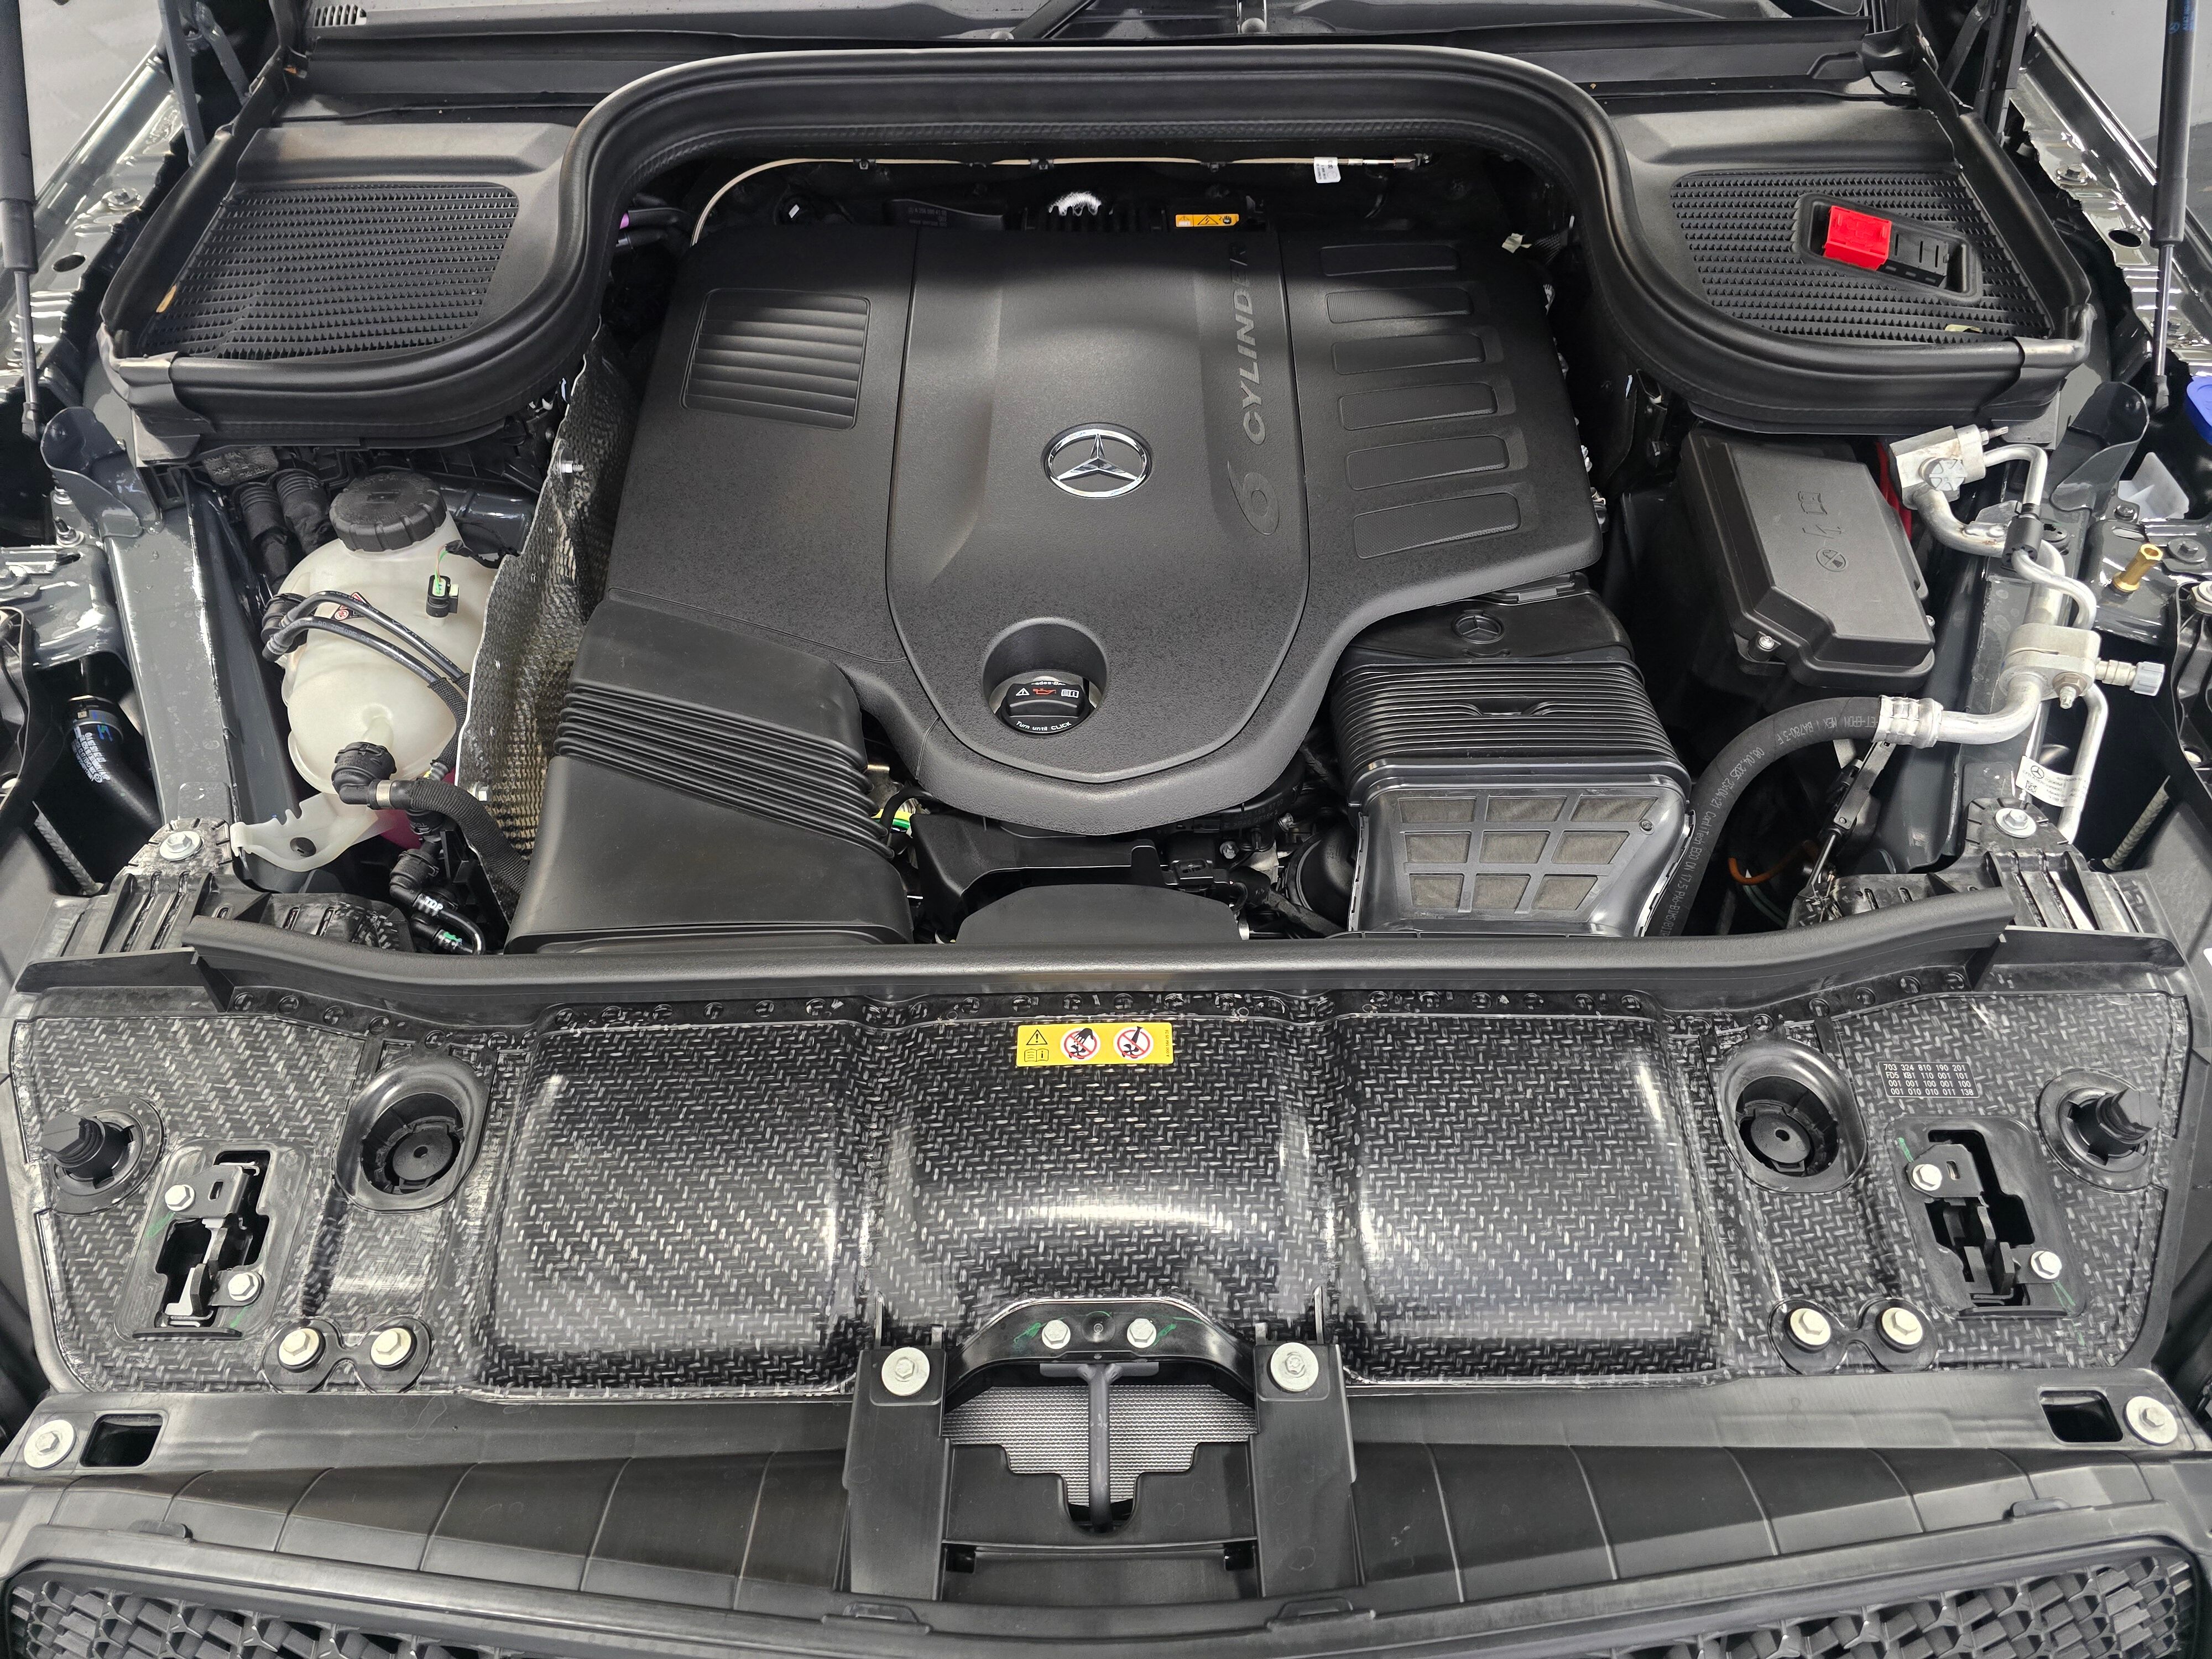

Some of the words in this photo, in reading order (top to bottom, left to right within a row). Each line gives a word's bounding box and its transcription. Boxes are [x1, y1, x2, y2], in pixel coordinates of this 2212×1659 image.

[1016, 721, 1030, 729] Turn
[1051, 721, 1072, 731] CLICK
[1823, 717, 1837, 729] MEX
[1694, 811, 1716, 845] ContiTech
[1688, 846, 1702, 860] ECO
[1684, 861, 1697, 872] DN
[424, 896, 444, 911] TOP
